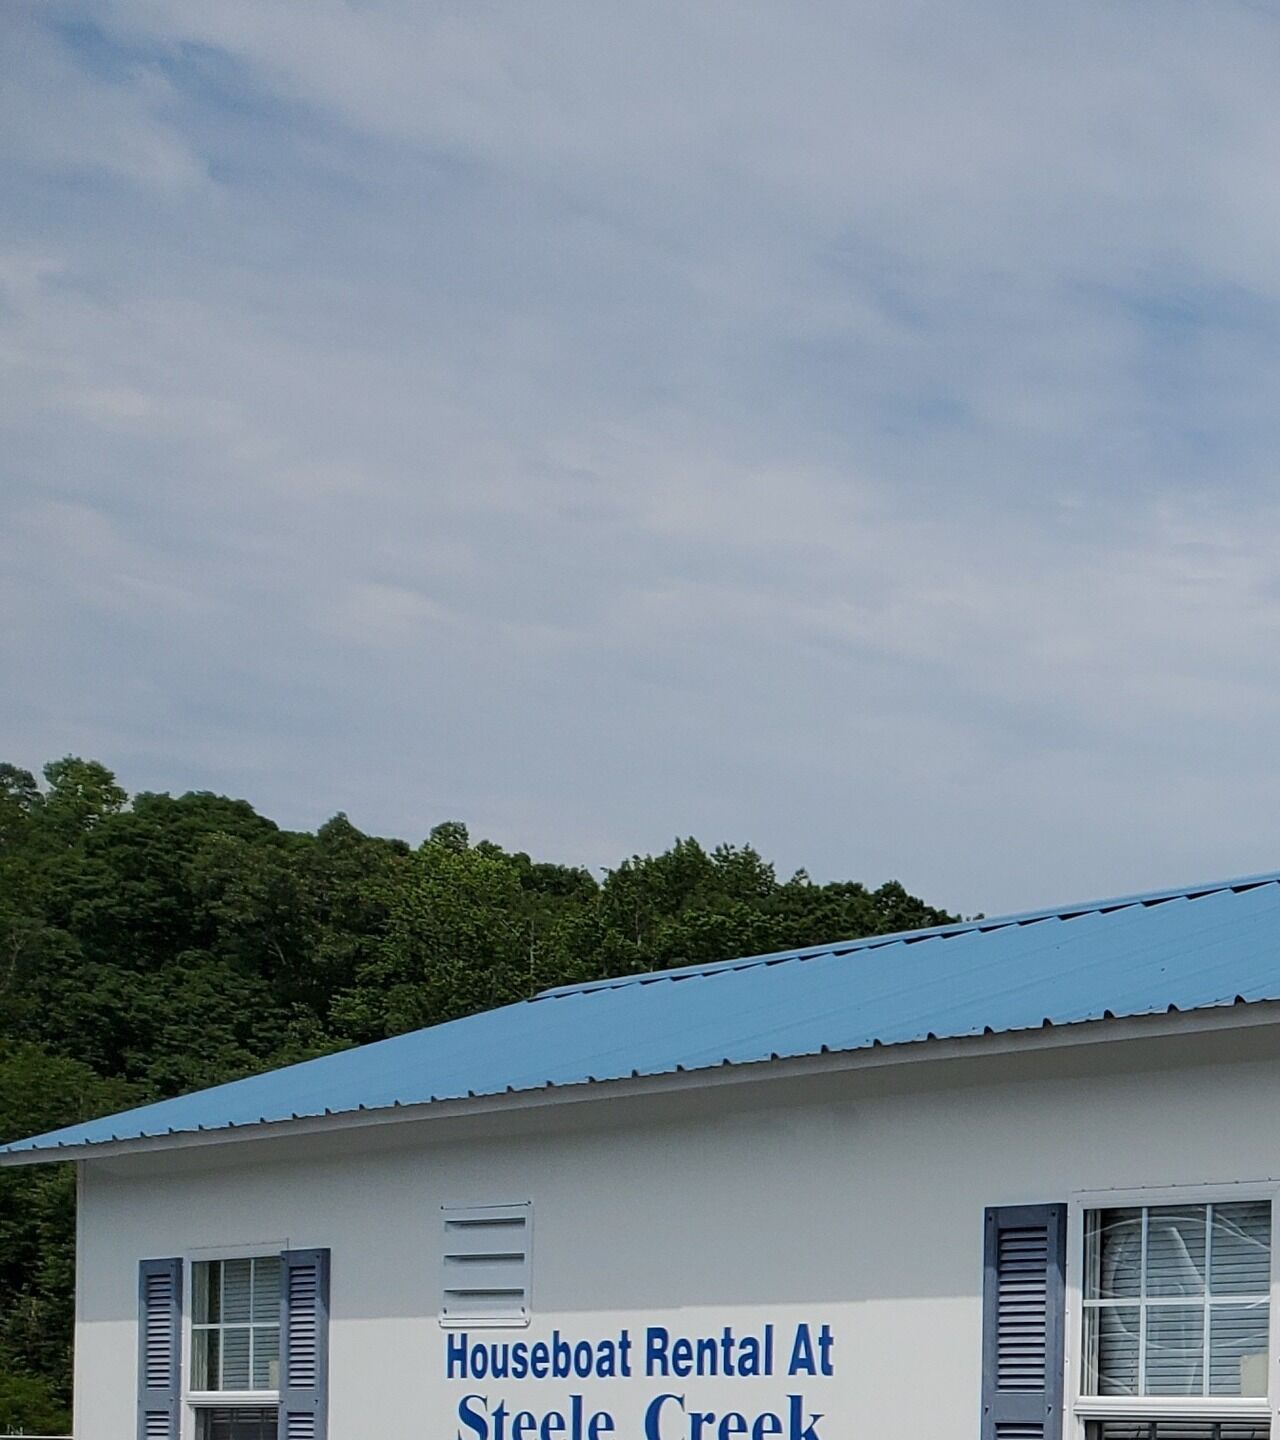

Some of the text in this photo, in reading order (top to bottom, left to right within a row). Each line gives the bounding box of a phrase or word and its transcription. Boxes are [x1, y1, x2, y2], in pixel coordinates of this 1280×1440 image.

[446, 1323, 835, 1379] Houseboat Rental At
